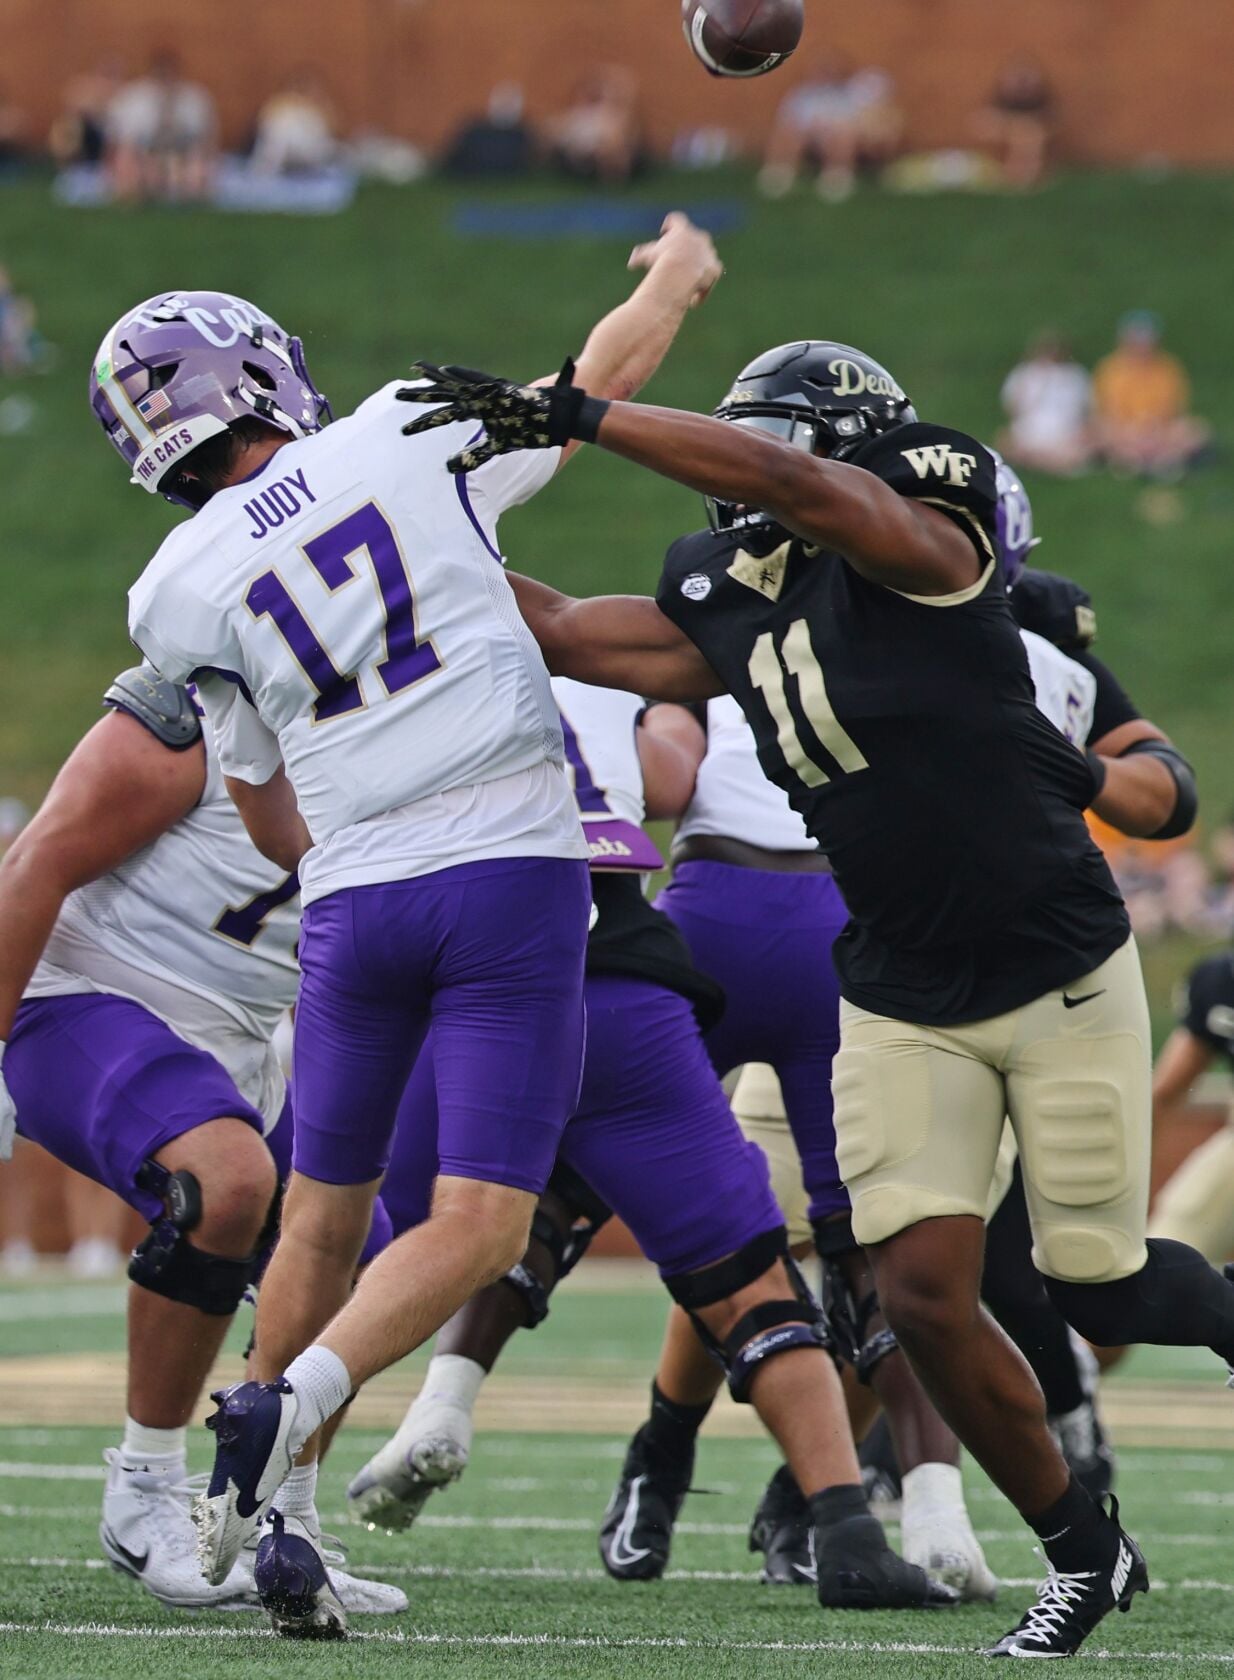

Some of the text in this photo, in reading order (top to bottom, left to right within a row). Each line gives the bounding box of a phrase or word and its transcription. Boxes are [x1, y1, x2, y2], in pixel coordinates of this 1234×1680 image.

[137, 428, 193, 481] THE CATS
[900, 444, 978, 487] WF
[242, 468, 317, 540] JUDY
[240, 496, 448, 728] 17
[747, 618, 870, 789] 11
